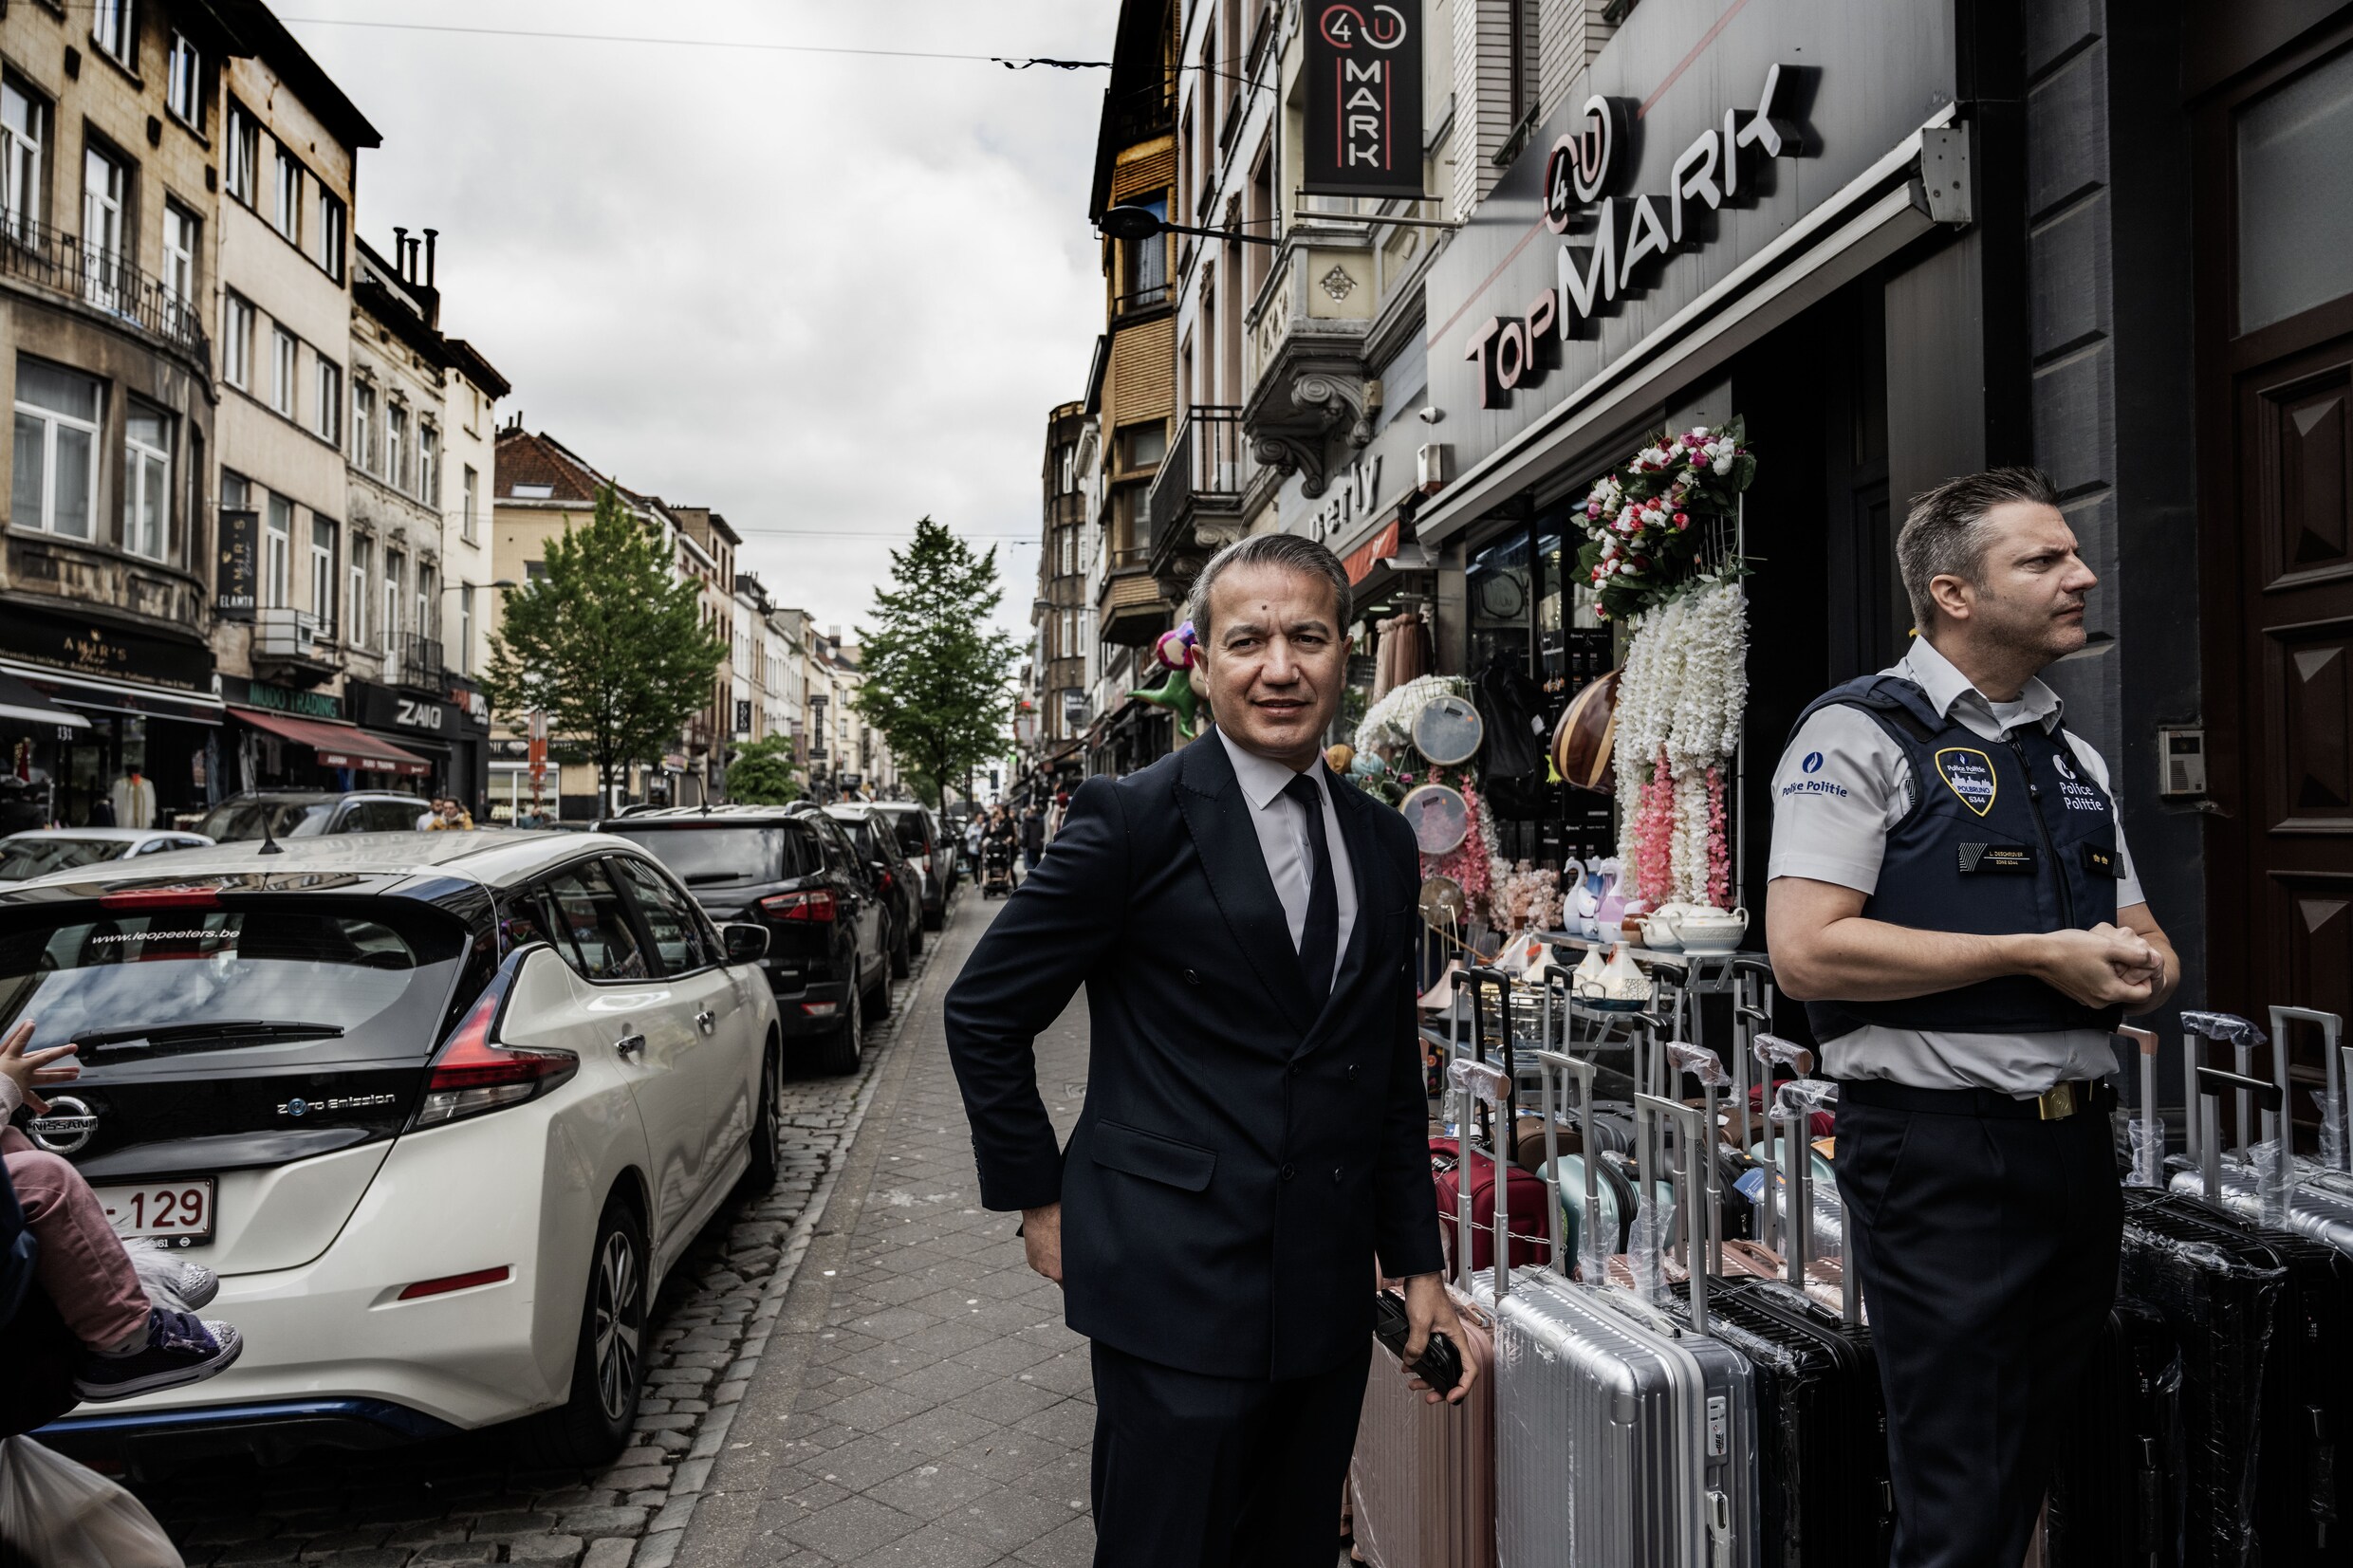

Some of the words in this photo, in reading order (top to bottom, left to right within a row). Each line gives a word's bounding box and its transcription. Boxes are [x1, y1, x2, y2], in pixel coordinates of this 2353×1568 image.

[1345, 58, 1381, 168] MARK
[249, 682, 285, 710] MUDO
[289, 691, 338, 718] TRADING
[57, 726, 73, 741] 131
[1782, 783, 1804, 798] Police
[1806, 781, 1848, 798] Politie
[1957, 785, 1991, 794] POLBRUNO
[2059, 782, 2094, 796] Police
[2064, 797, 2104, 811] Politie
[92, 929, 240, 945] www.leopeeters.be
[327, 1094, 396, 1110] Emission
[32, 1120, 89, 1132] NISSAN
